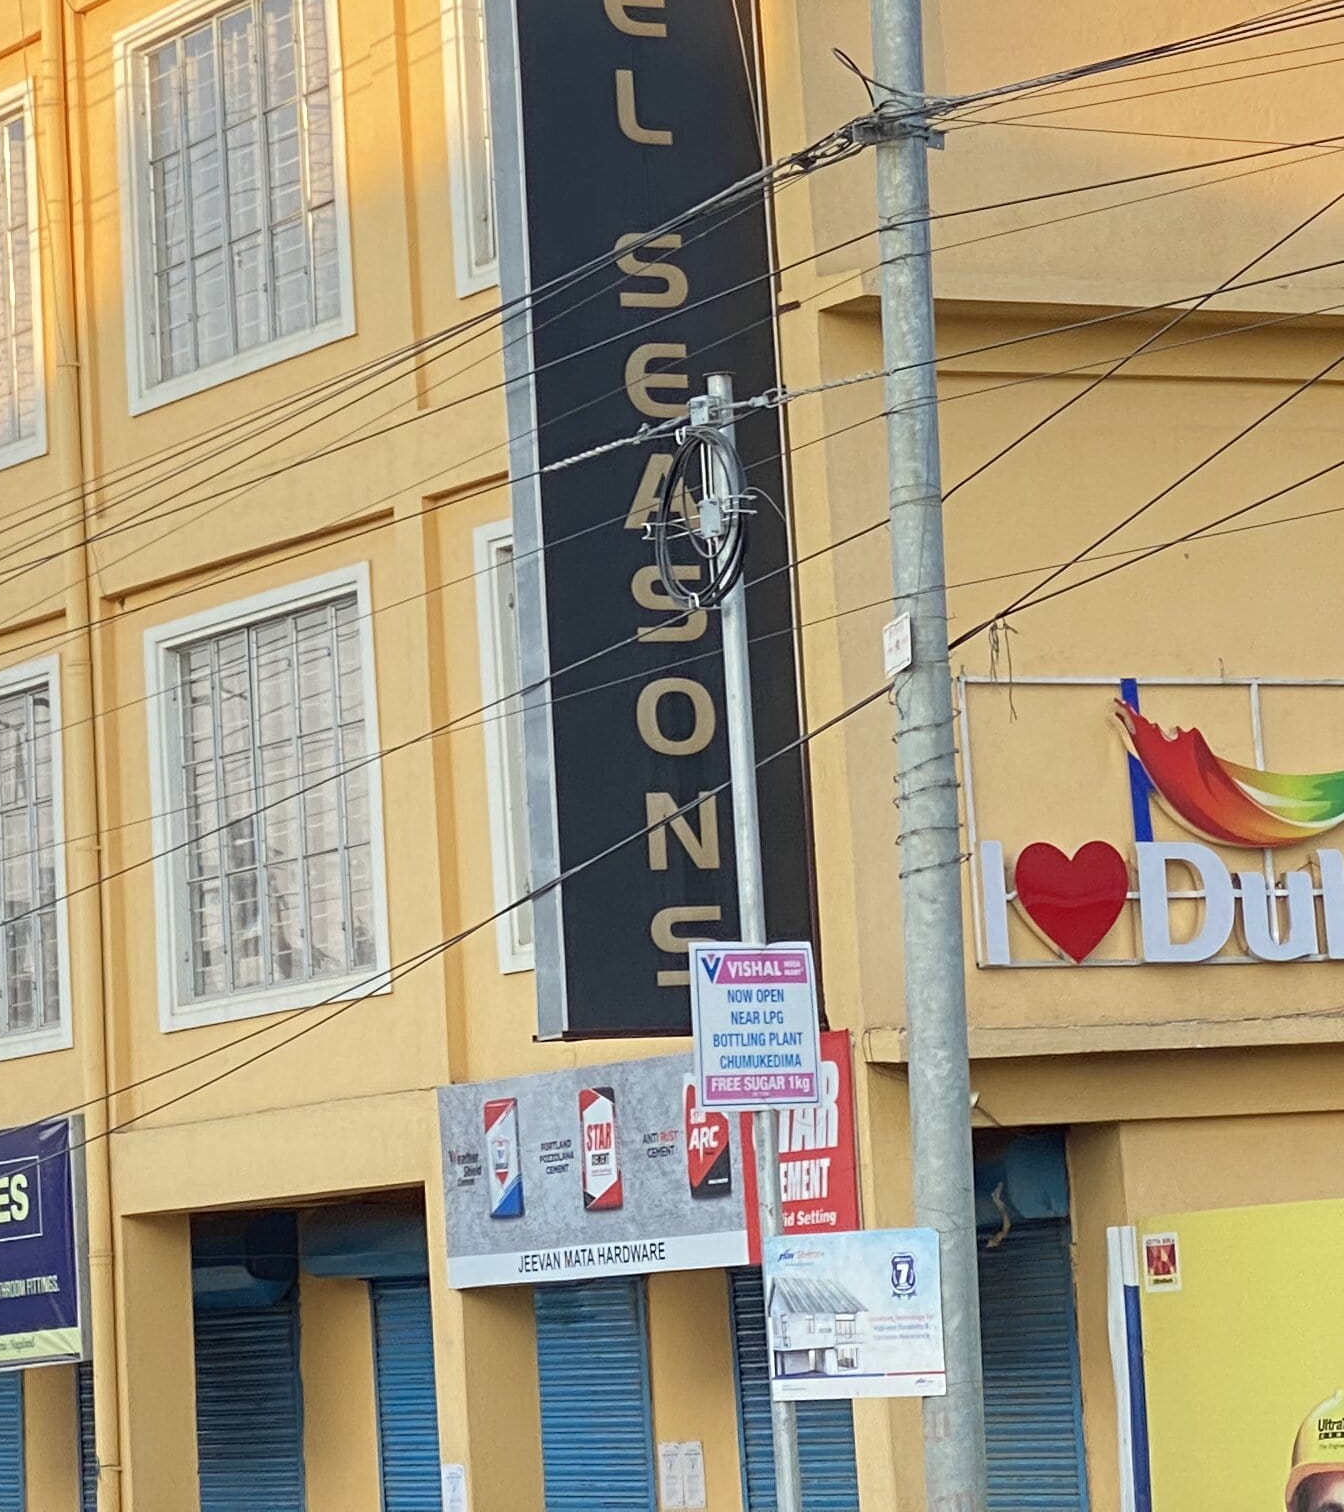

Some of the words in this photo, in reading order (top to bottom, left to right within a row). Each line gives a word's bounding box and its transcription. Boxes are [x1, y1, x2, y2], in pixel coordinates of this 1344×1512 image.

[615, 232, 722, 986] SEASONS
[727, 960, 783, 979] VISHAL
[727, 989, 753, 1003] NOW
[756, 988, 785, 1003] OPEN
[730, 1011, 761, 1025] NEAR
[763, 1010, 784, 1024] LPG
[712, 1033, 766, 1048] BOTTLING
[769, 1031, 803, 1046] PLANT
[719, 1053, 802, 1069] CHUMUKEDIMA
[711, 1076, 742, 1092] FREE
[744, 1075, 786, 1091] SUGAR
[788, 1075, 811, 1093] 1kg
[586, 1121, 612, 1152] STAR
[643, 1132, 658, 1144] ANTI
[688, 1126, 720, 1155] ARC
[647, 1144, 675, 1158] CEMENT
[779, 1157, 831, 1202] EMENT
[797, 1208, 837, 1227] Setting
[518, 1251, 561, 1273] JEEVAN
[564, 1247, 596, 1268] MATA
[598, 1242, 666, 1265] HARDWARE
